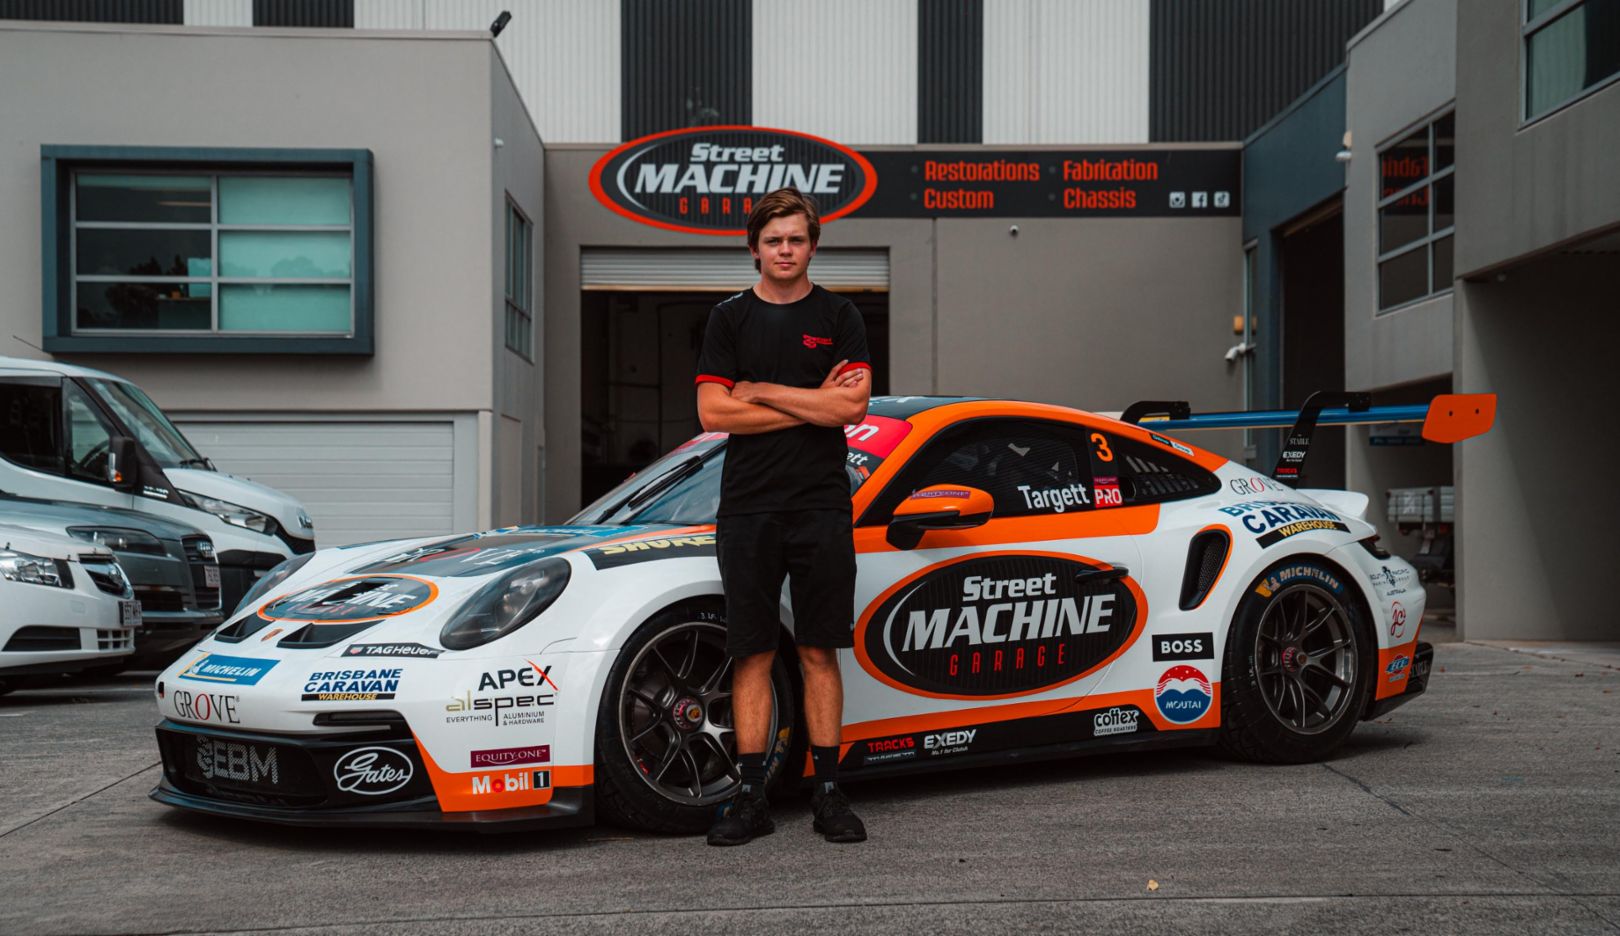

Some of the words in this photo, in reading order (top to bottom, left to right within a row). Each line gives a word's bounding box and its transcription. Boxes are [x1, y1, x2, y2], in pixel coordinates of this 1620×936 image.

[690, 143, 785, 162] Street
[634, 163, 846, 193] MACHINE
[924, 159, 1040, 182] Restorations
[1063, 158, 1158, 181] Fabrication
[679, 197, 752, 214] GARA
[924, 188, 994, 209] Custom
[1063, 187, 1136, 208] Chassis
[1090, 432, 1113, 462] 3
[1017, 483, 1090, 513] Targett
[1094, 488, 1122, 504] PRO
[1278, 520, 1338, 537] WAREHOUSE
[598, 535, 716, 555] SHURE
[962, 572, 1057, 601] Street
[1279, 566, 1339, 590] MICHELIN
[901, 593, 1116, 652] MACHINE
[1160, 639, 1203, 654] BOSS
[949, 643, 1066, 676] GARAGE
[201, 664, 262, 677] MICHELIN
[308, 668, 403, 681] BRISBANE
[478, 658, 558, 691] APEX
[303, 679, 400, 693] CARAVAN
[318, 692, 379, 701] WAREHOUSE
[174, 690, 241, 724] GROVE
[446, 689, 554, 726] alspec
[1165, 700, 1202, 709] MOUTAI
[446, 714, 493, 723] EVERYTHING
[503, 711, 544, 720] ALUMINIUM
[508, 717, 544, 725] HARDWARE
[866, 736, 916, 753] TRACKS
[923, 728, 977, 749] EXEDY
[338, 752, 407, 791] Gates
[472, 773, 529, 795] Mobil
[538, 772, 544, 787] 1
